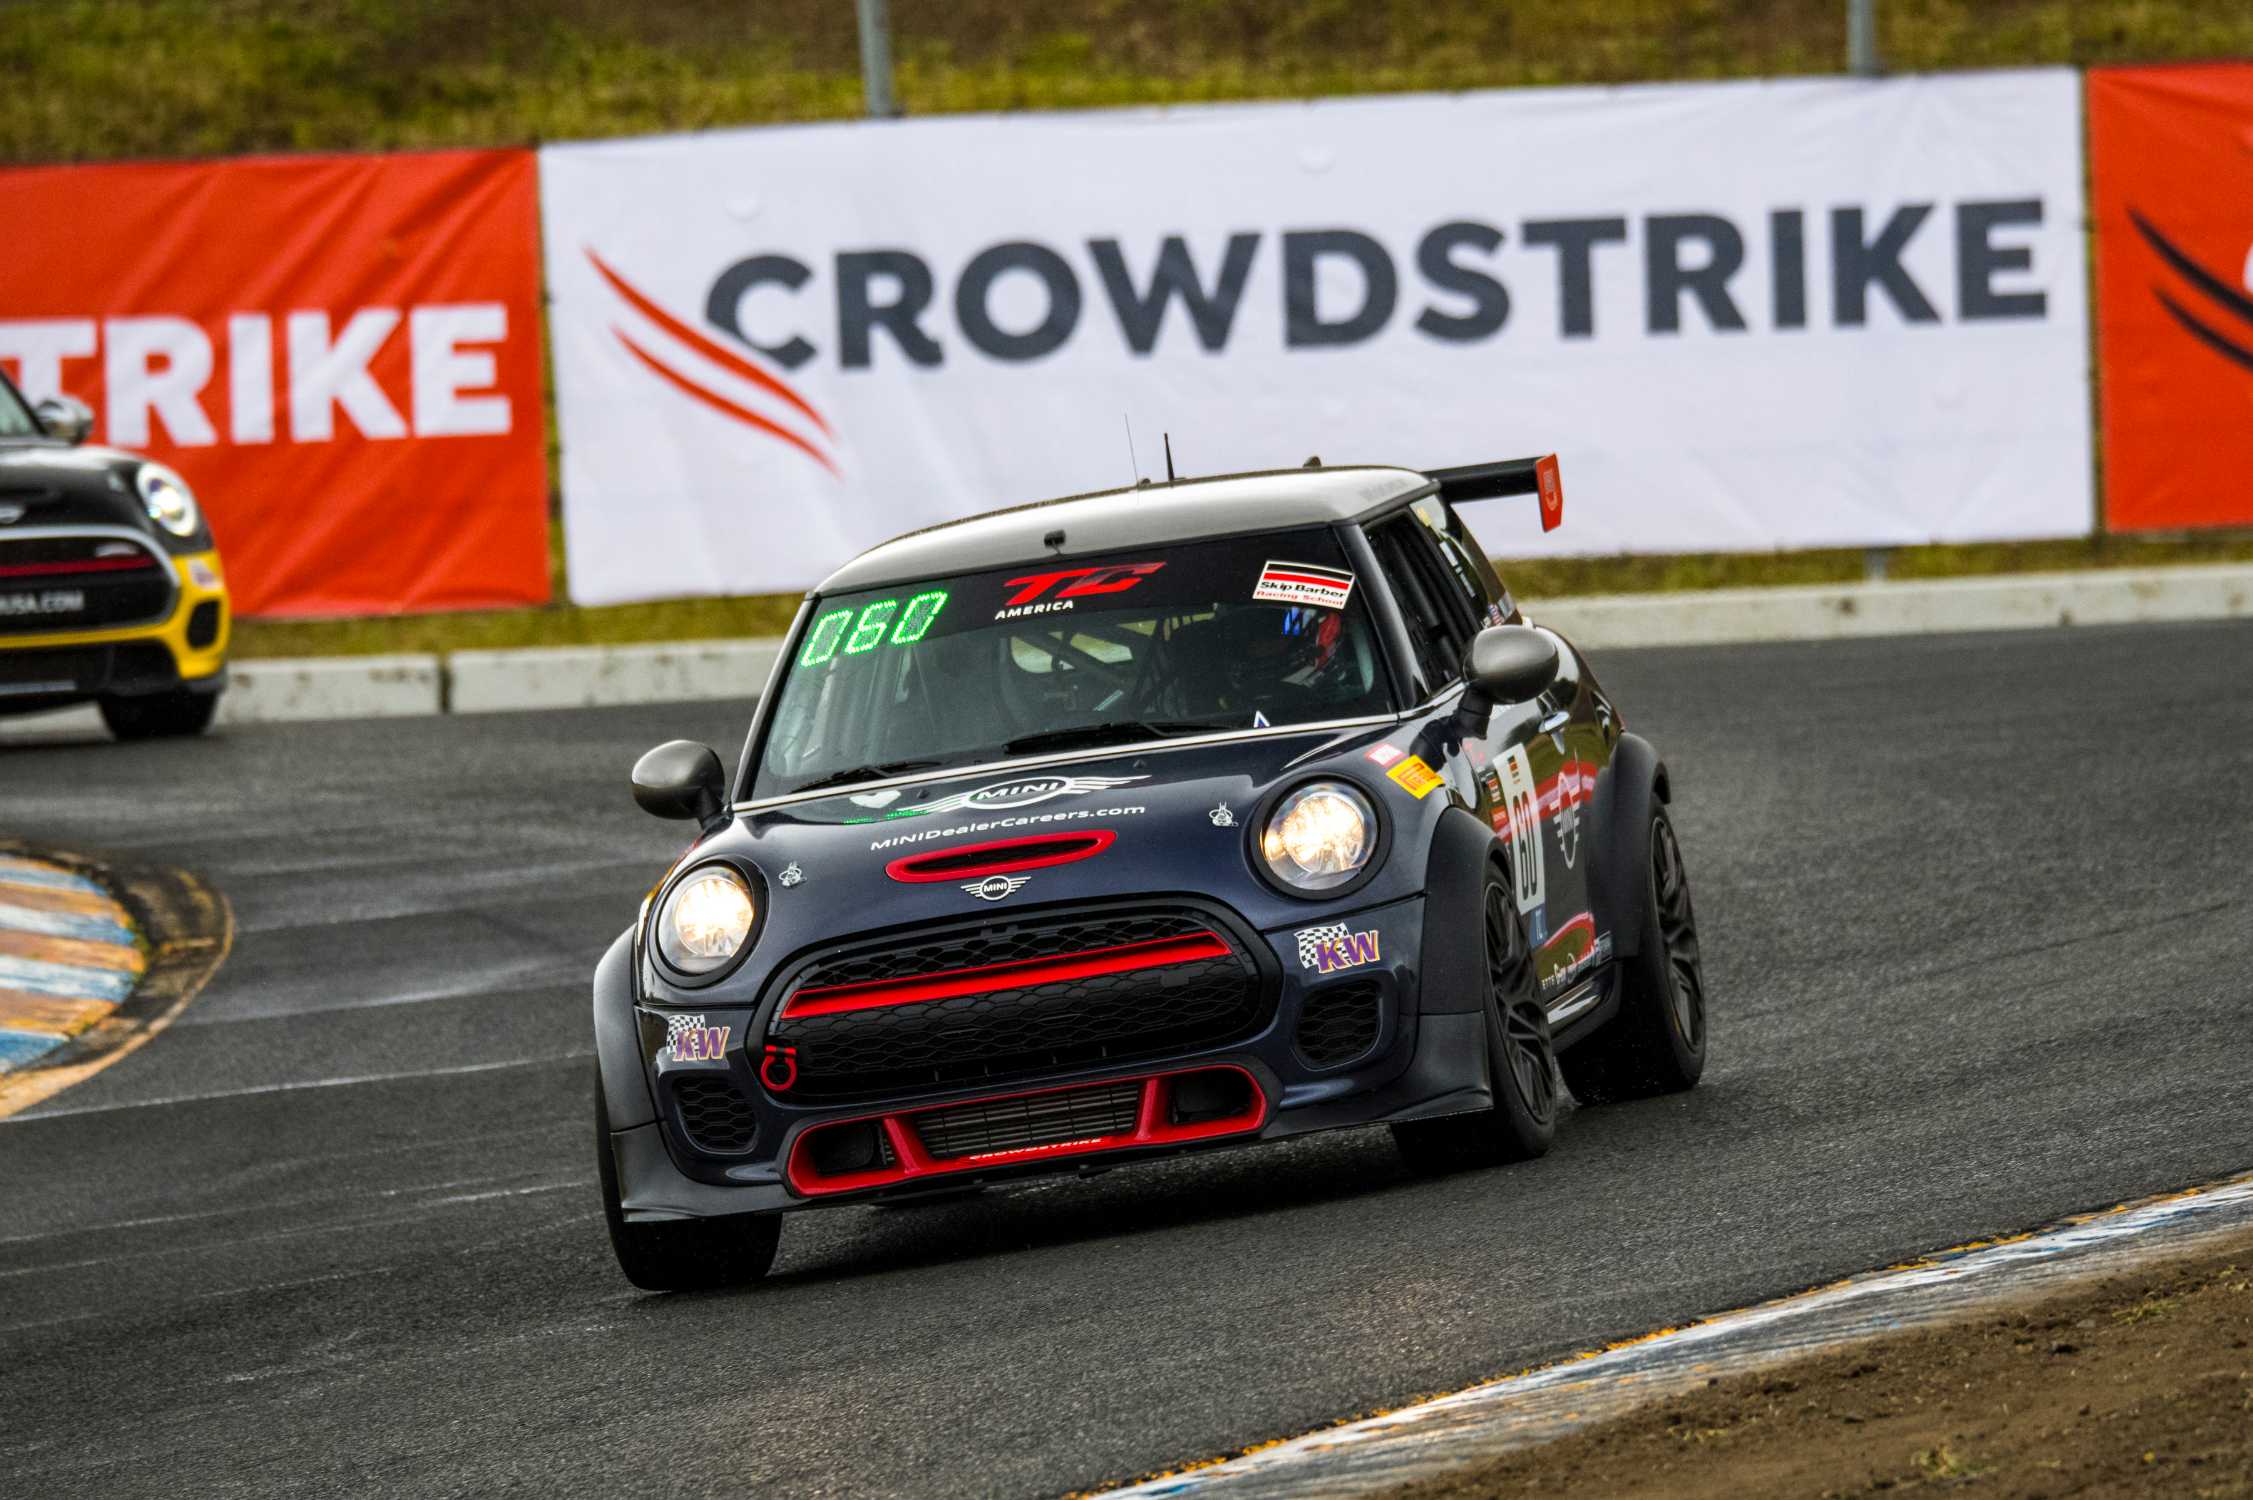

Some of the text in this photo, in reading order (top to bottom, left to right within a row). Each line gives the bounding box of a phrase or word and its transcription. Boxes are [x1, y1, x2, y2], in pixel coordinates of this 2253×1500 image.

[706, 197, 2048, 371] CROWDSTRIKE
[1004, 561, 1168, 606] TC
[1259, 581, 1346, 597] Skip Barber
[800, 590, 948, 667] 060
[994, 600, 1074, 620] AMERICA
[976, 782, 1059, 801] MINI
[870, 805, 1146, 852] MINIDealerCareers.com
[1512, 791, 1538, 901] 60
[983, 882, 1008, 893] MINI
[1314, 929, 1381, 974] KW
[672, 1026, 731, 1062] KW
